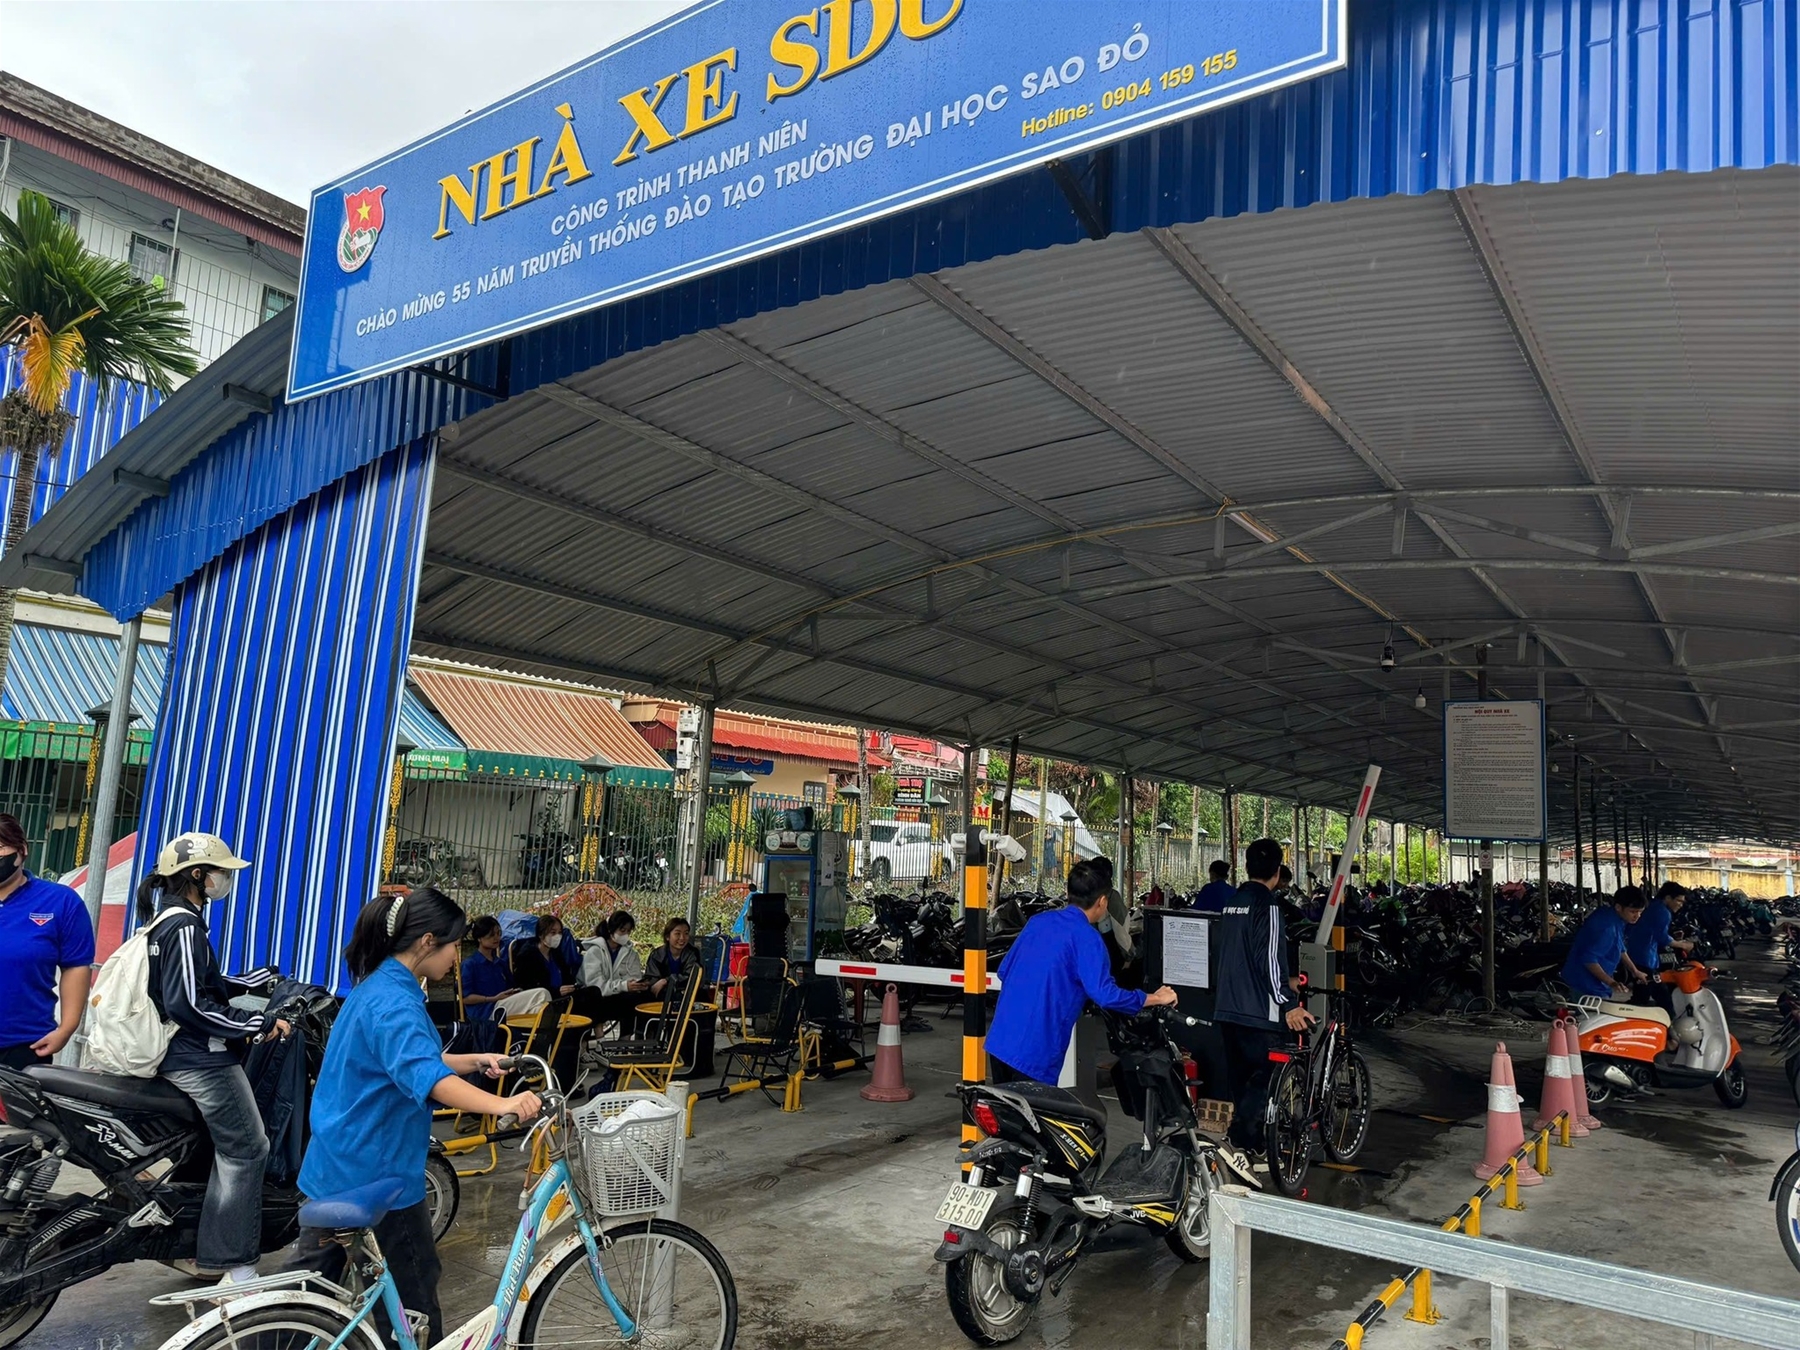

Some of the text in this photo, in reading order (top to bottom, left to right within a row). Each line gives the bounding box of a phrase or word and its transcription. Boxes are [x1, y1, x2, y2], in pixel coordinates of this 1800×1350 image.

[431, 103, 593, 240] NHÀ
[612, 47, 738, 166] XE
[1021, 48, 1239, 139] Hotline: 0904 159 155
[356, 22, 1150, 337] CHÀO MỪNG 55 NĂM TRUYỀN THỐNG ĐÀO TẠO TRƯỜNG ĐẠI HỌC SAO ĐỎ
[551, 119, 808, 237] CÔNG TRÌNH THANH NIÊN
